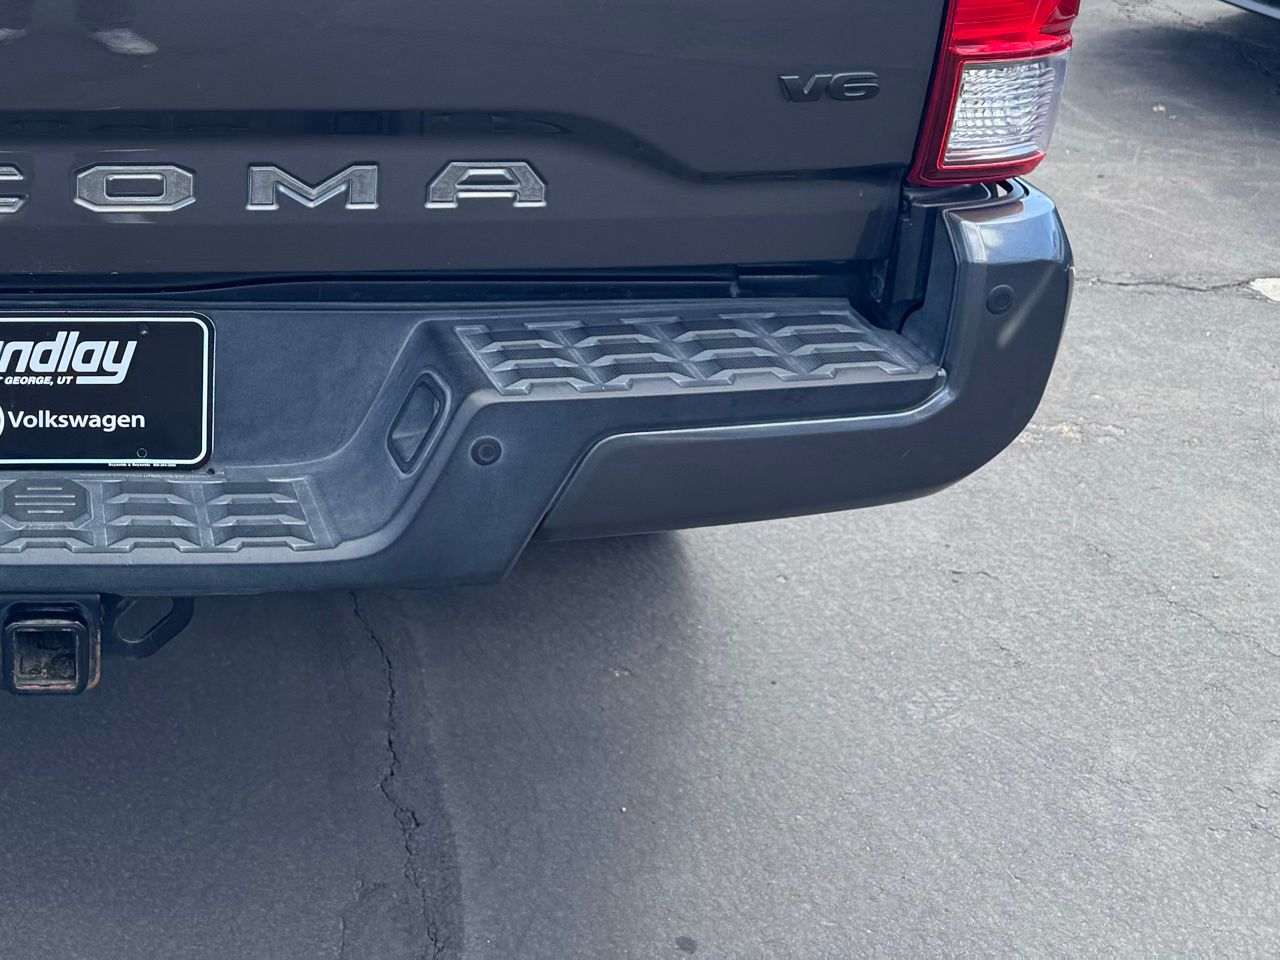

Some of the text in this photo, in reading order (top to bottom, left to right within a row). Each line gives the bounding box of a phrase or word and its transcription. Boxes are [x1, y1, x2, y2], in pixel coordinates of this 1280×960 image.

[778, 71, 880, 103] V6
[4, 375, 55, 387] GEORGE,
[56, 375, 74, 386] UT
[7, 410, 146, 433] Volkswagen
